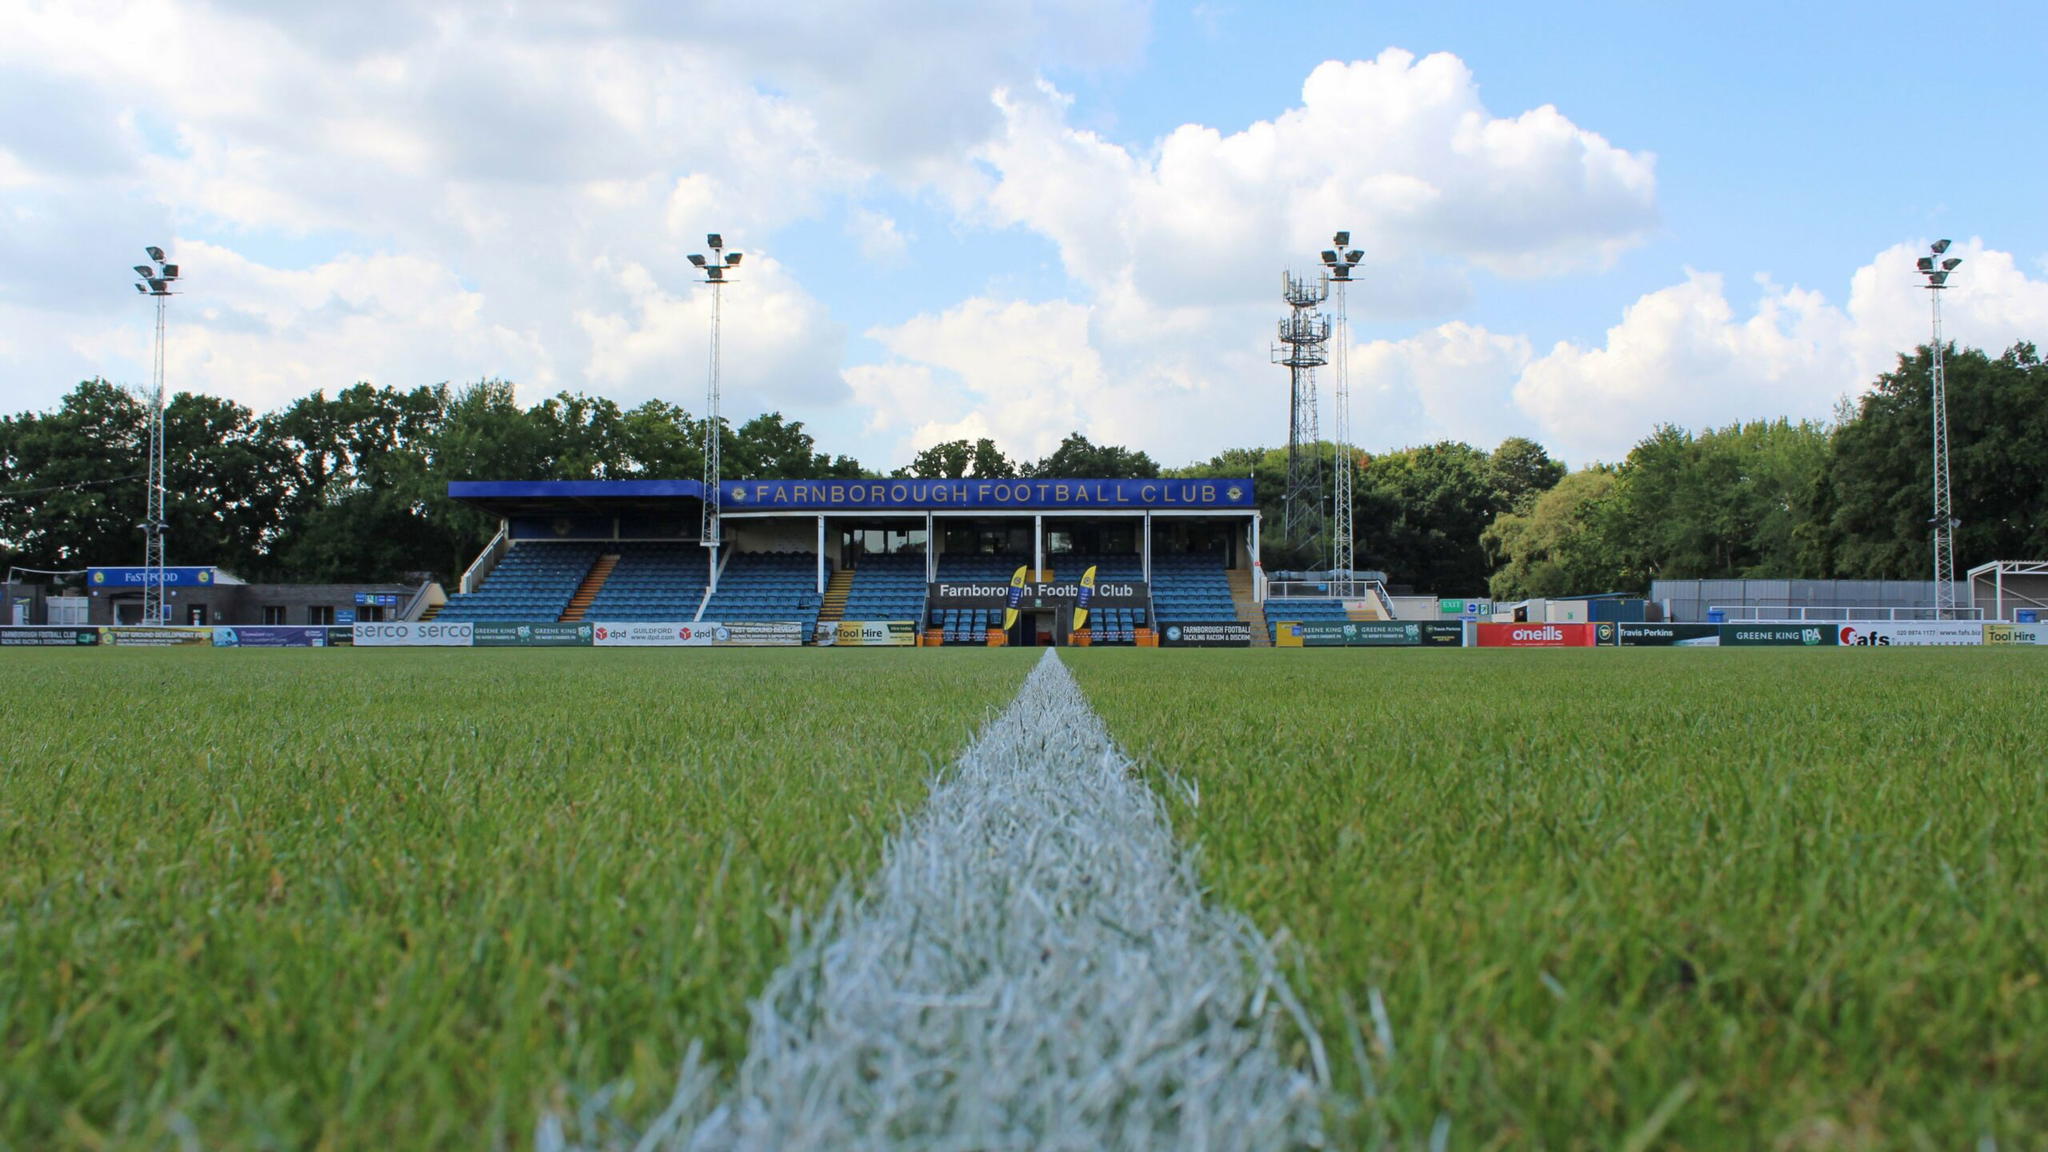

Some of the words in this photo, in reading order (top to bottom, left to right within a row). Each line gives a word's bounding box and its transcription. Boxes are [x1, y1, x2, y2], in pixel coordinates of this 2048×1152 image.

[756, 485, 967, 503] FARNBOROUGH
[978, 484, 1129, 502] FOOTBALL
[1141, 484, 1216, 502] CLUB
[940, 584, 1032, 598] Farnboroh
[1038, 584, 1095, 597] Footbl
[1100, 584, 1133, 597] Club
[355, 624, 408, 638] serco
[418, 624, 471, 638] serco
[610, 630, 626, 639] dpd
[694, 630, 711, 639] dpd
[838, 628, 859, 637] Tool
[862, 628, 883, 637] Hire
[1183, 625, 1223, 633] FARNBOROUGH
[1736, 631, 1773, 640] GREENE
[1775, 631, 1800, 640] KING
[1802, 628, 1822, 641] IPA
[1989, 631, 2011, 641] Tool
[2014, 631, 2036, 641] Hire
